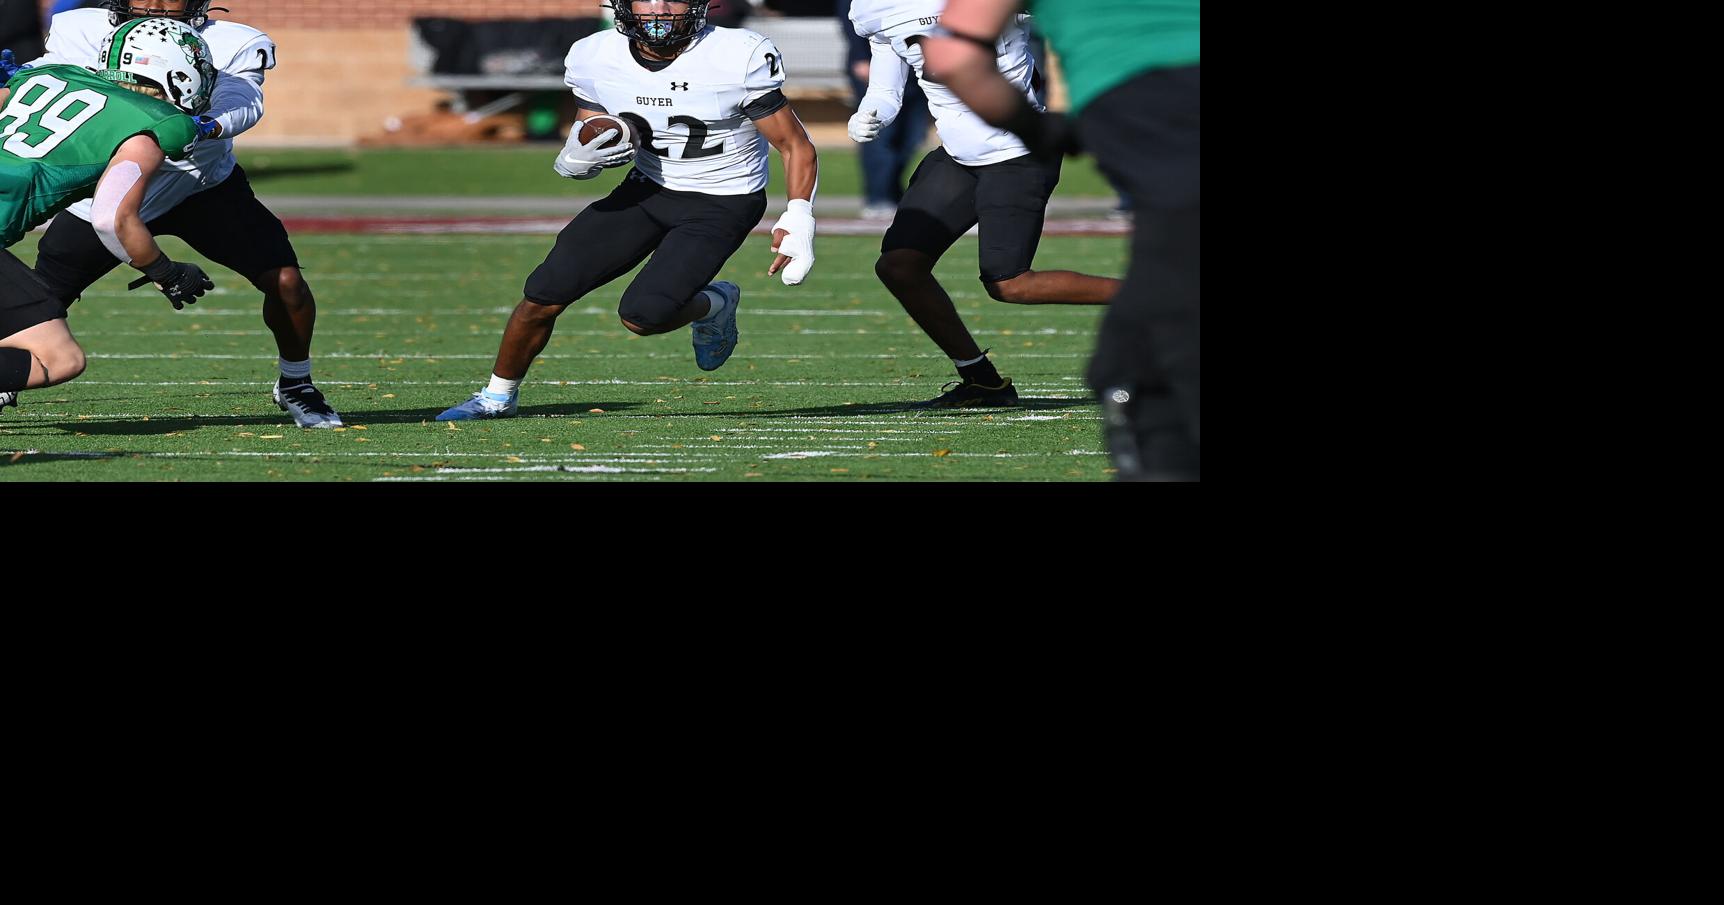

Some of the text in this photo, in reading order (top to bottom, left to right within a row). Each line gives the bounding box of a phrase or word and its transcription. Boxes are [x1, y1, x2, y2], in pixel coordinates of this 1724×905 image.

[918, 16, 939, 26] GUY
[101, 50, 133, 65] 8 9
[636, 96, 673, 107] GUYER
[0, 74, 109, 159] 89
